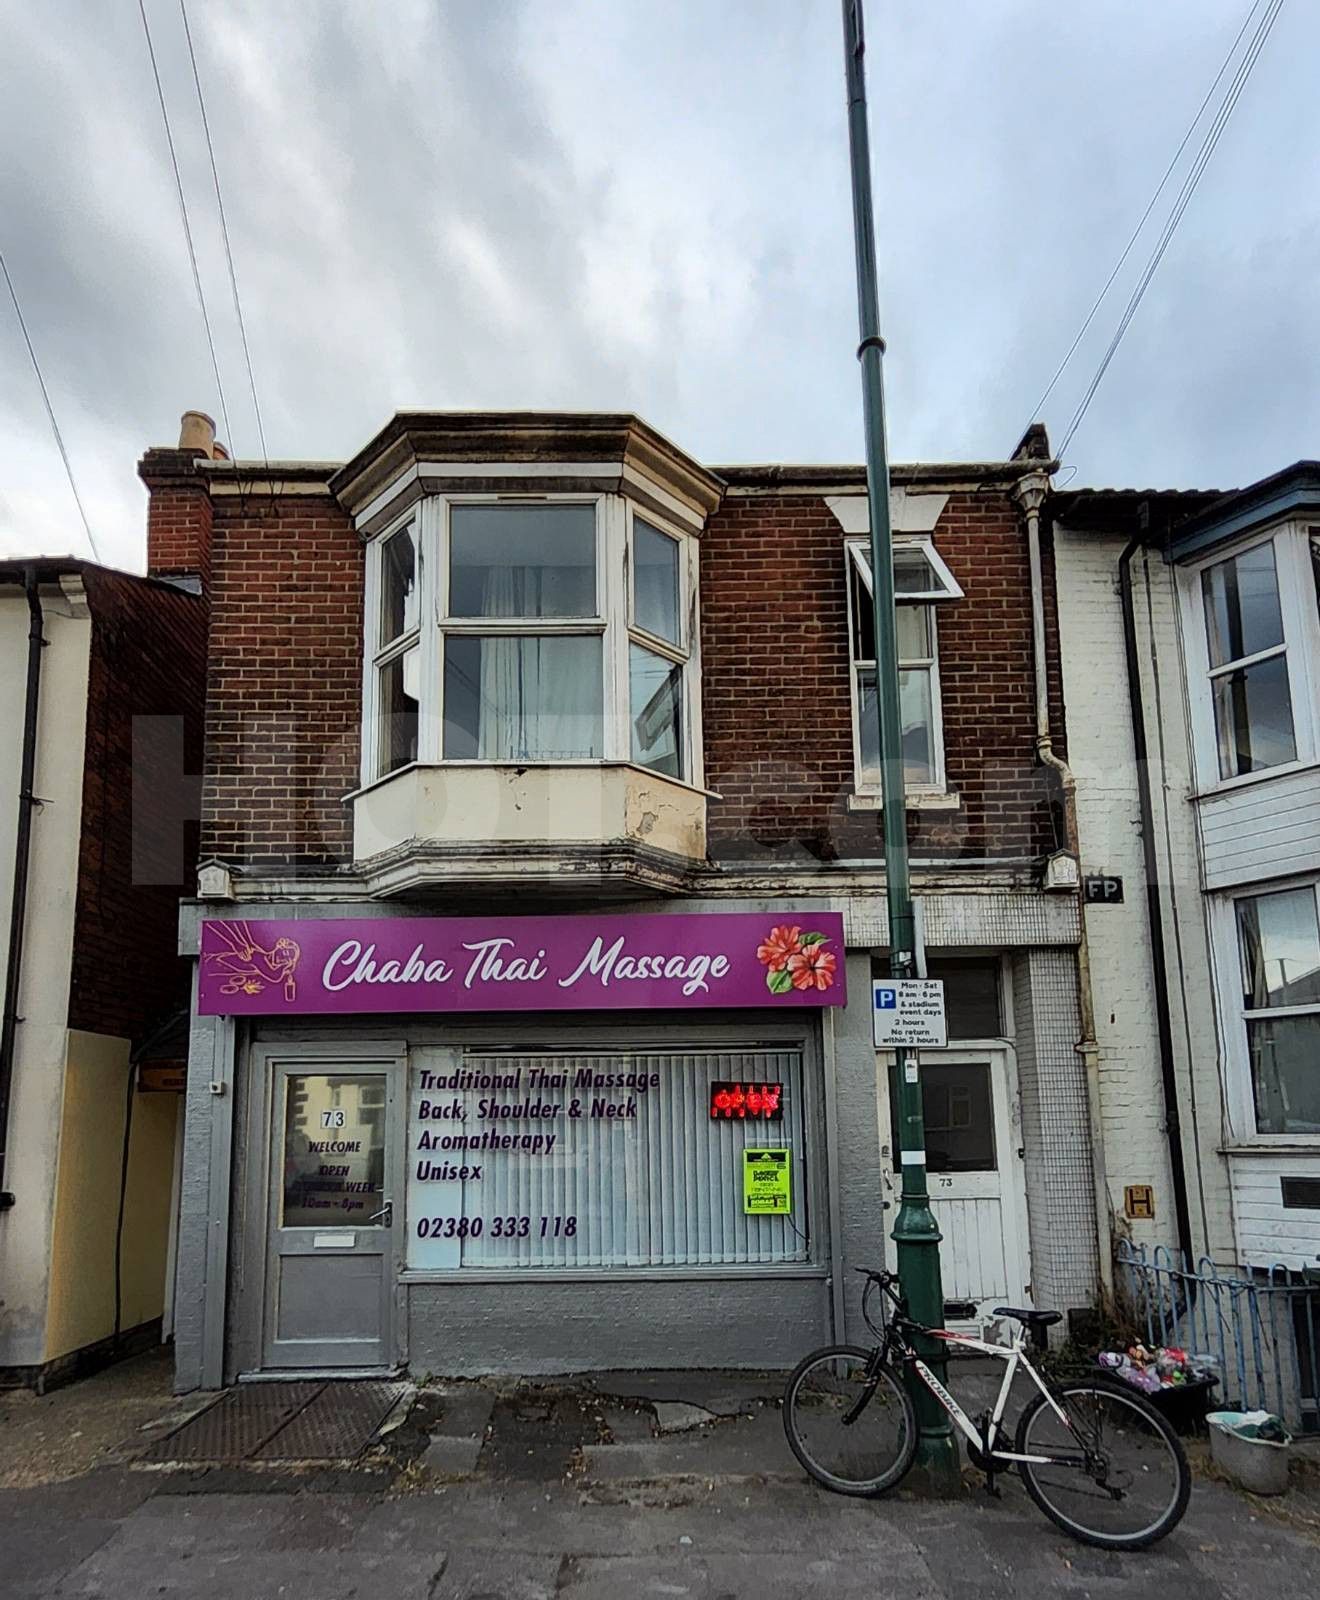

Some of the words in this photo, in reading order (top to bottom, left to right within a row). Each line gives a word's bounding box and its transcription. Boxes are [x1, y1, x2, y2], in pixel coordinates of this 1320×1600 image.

[1088, 880, 1117, 898] FP
[322, 939, 454, 991] Chaba
[462, 937, 549, 989] Thai
[558, 936, 732, 996] Massage
[880, 991, 893, 1007] P
[923, 1009, 942, 1017] days
[419, 1068, 521, 1090] Traditional
[528, 1068, 568, 1088] Thai
[573, 1068, 660, 1093] Massage
[418, 1099, 468, 1122] Back,
[476, 1098, 561, 1119] Shoulder
[567, 1100, 582, 1118] &
[590, 1097, 637, 1118] Neck
[322, 1111, 344, 1127] 73
[308, 1141, 361, 1152] WELCOME
[417, 1128, 556, 1154] Aromatherapy
[319, 1165, 350, 1176] OPEN
[416, 1160, 482, 1181] Unisex
[939, 1178, 953, 1187] 73
[417, 1217, 482, 1238] 02380
[491, 1217, 530, 1237] 333
[539, 1217, 577, 1237] 118
